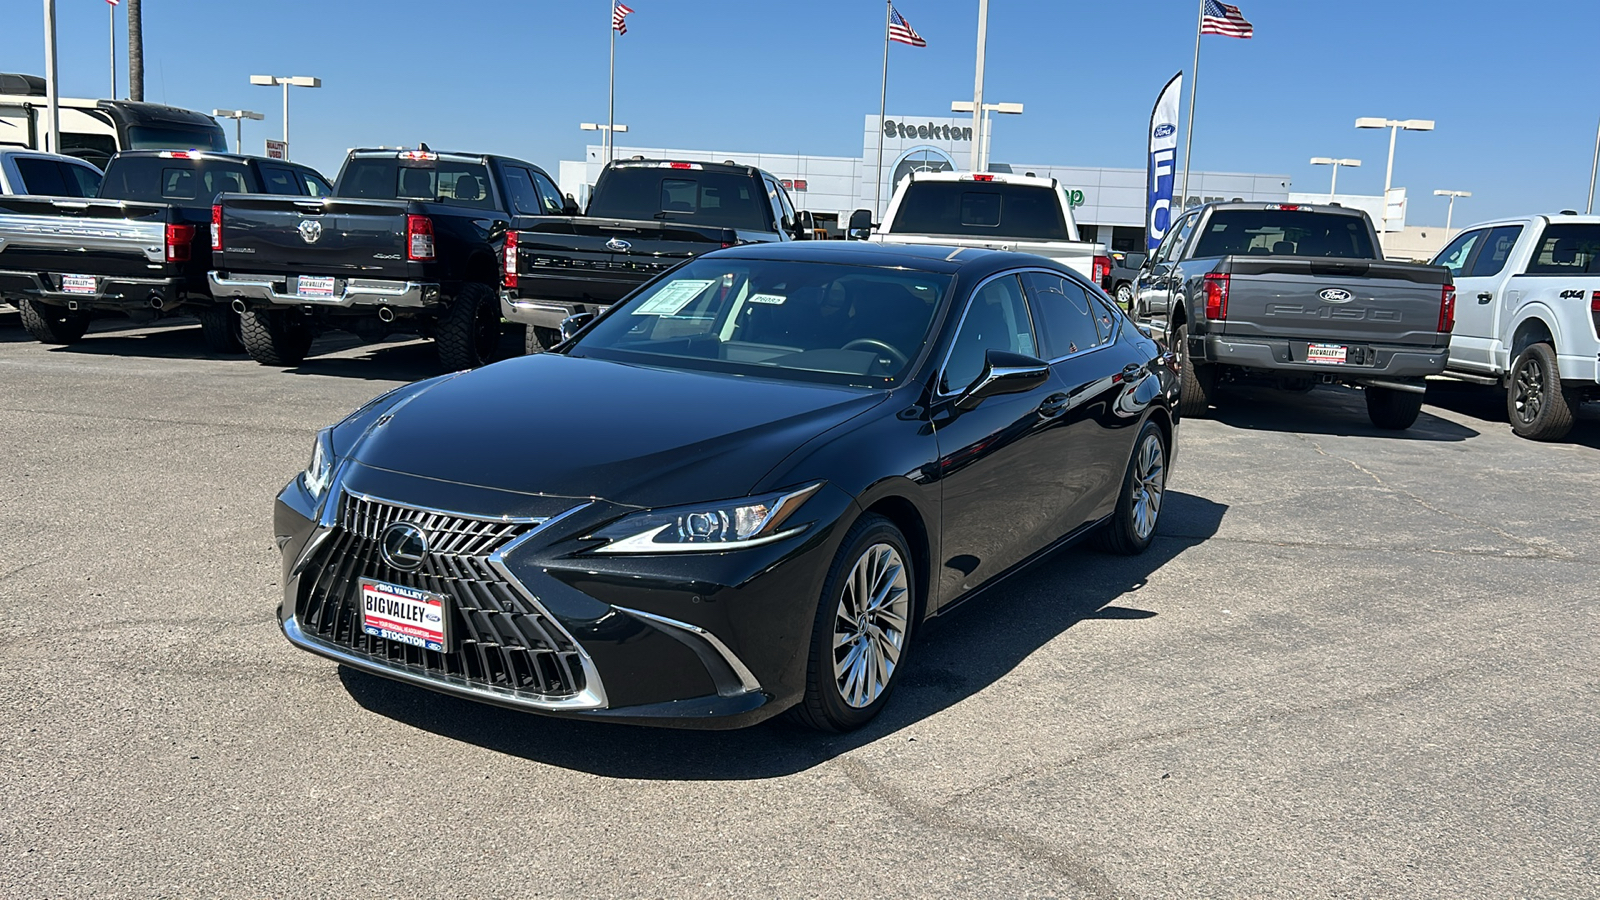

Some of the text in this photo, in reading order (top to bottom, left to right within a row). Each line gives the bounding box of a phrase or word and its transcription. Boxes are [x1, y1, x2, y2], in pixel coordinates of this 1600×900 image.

[884, 120, 974, 141] Stockton
[1155, 125, 1173, 137] Ford
[269, 150, 282, 158] USED
[1324, 289, 1348, 301] Ford
[1265, 303, 1403, 322] F-150
[1309, 348, 1338, 357] BIGVALLEY
[379, 584, 423, 599] BIG VALLEY
[366, 594, 425, 623] BIGVALLEY
[381, 629, 426, 647] STOCKTON
